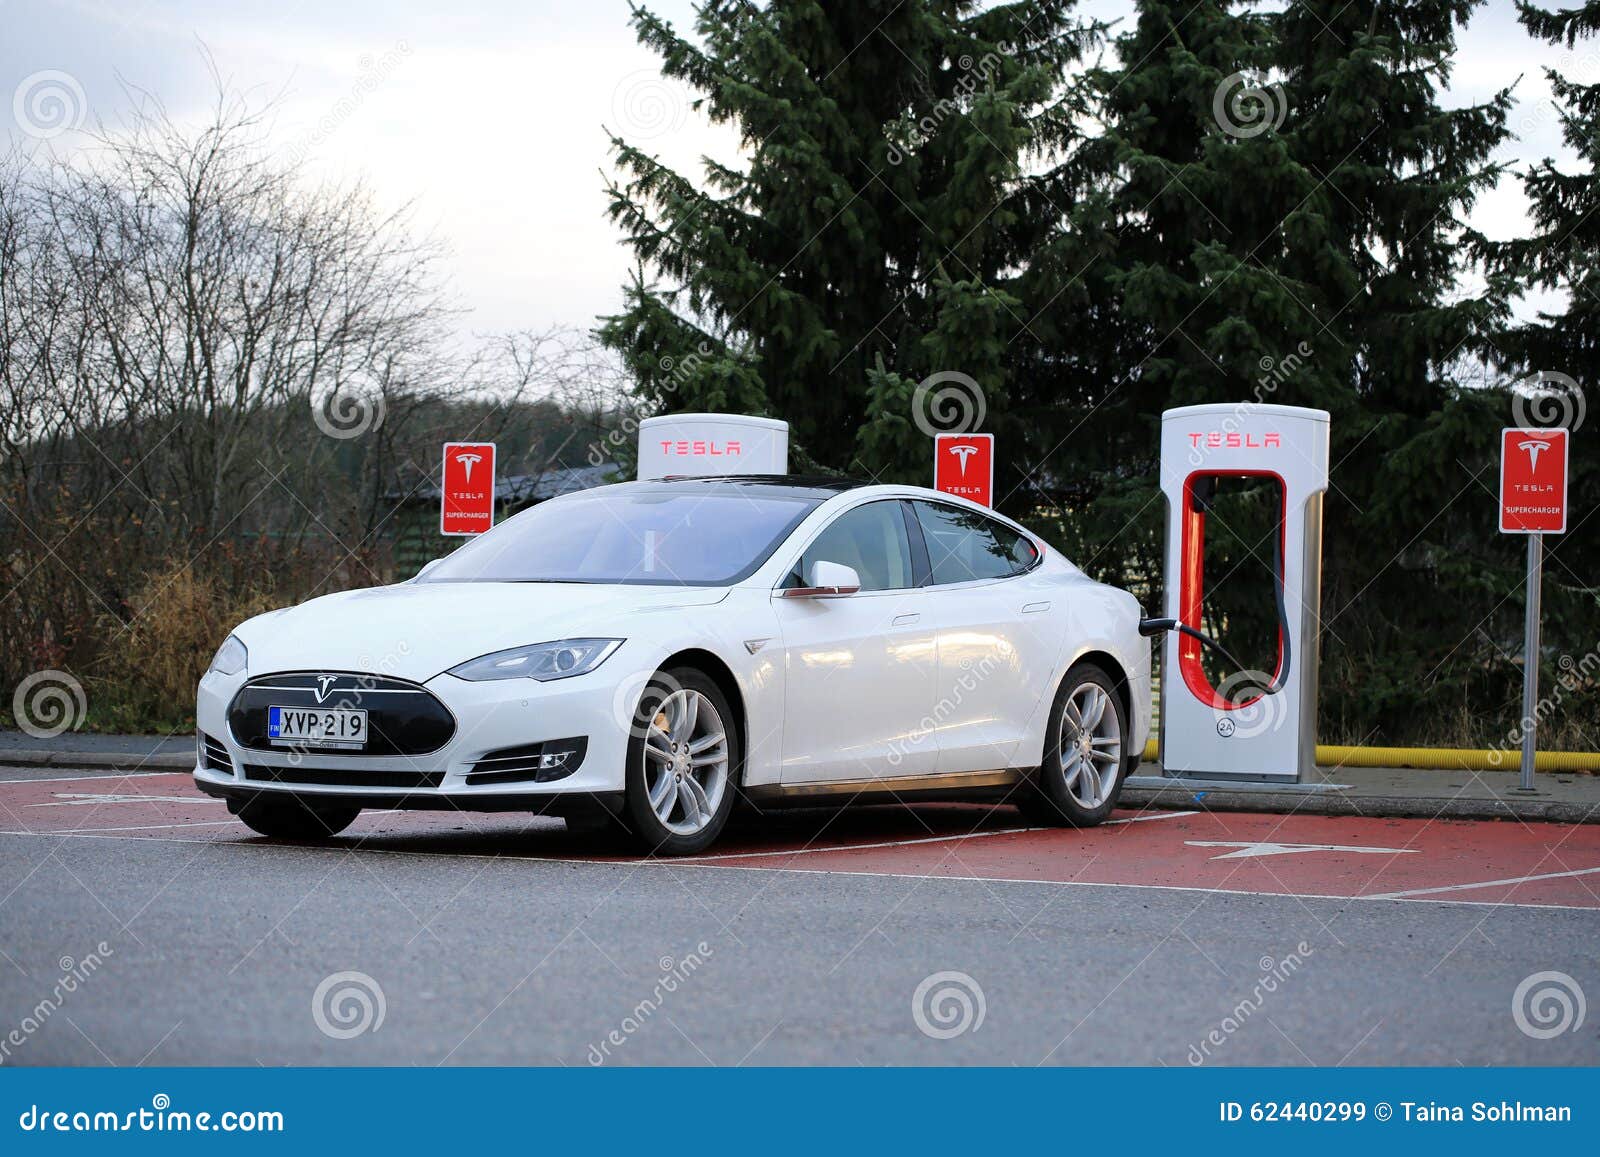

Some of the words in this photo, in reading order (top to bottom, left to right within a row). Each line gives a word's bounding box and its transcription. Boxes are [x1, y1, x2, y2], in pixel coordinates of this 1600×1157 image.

[1188, 433, 1280, 447] TESLA
[660, 441, 741, 455] TESLA
[946, 486, 982, 494] TESLA
[1514, 484, 1553, 492] TESLA
[1505, 506, 1561, 514] SUPERCHARGER
[283, 712, 362, 737] XVP-219
[1220, 723, 1232, 731] 2A
